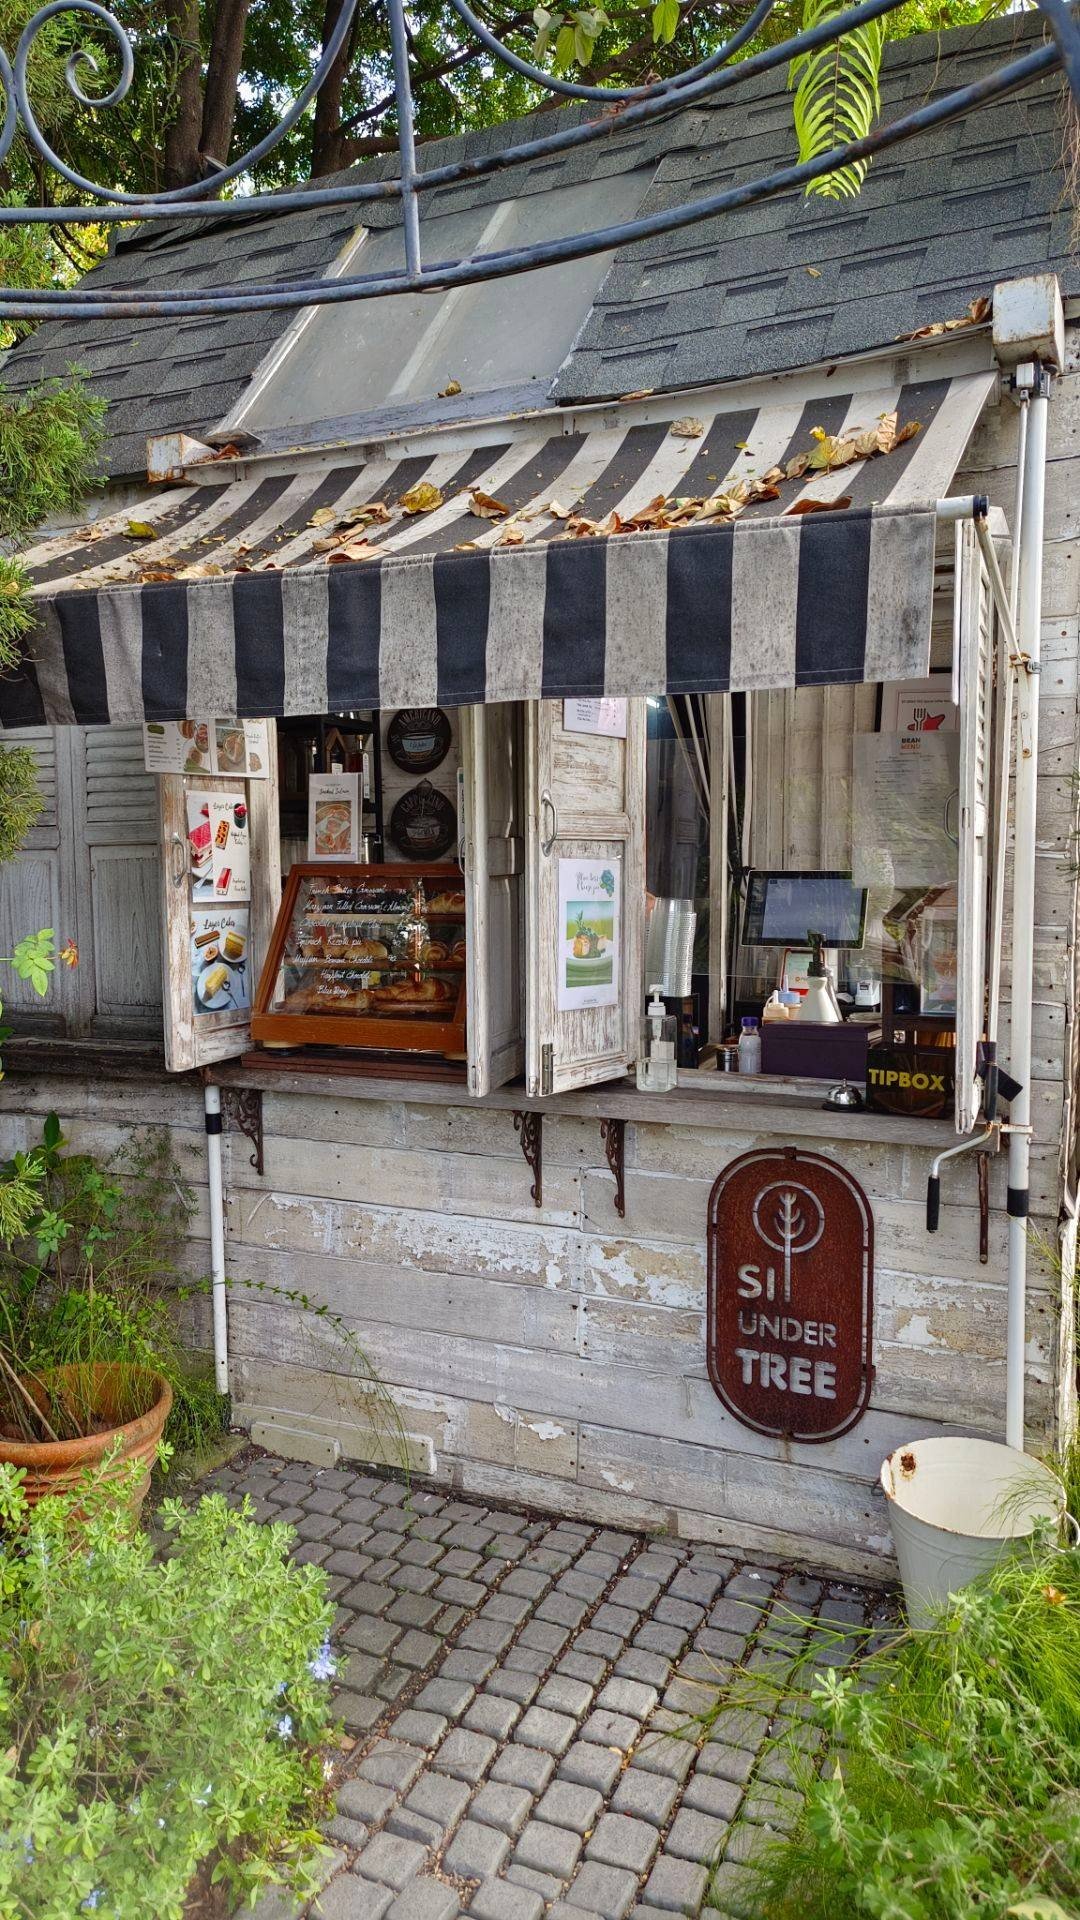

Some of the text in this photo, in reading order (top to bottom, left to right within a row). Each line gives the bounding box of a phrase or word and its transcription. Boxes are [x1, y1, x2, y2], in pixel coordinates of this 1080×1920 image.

[868, 1068, 946, 1092] TIPBOX
[737, 1310, 838, 1349] UNDER
[734, 1347, 838, 1400] TREE
